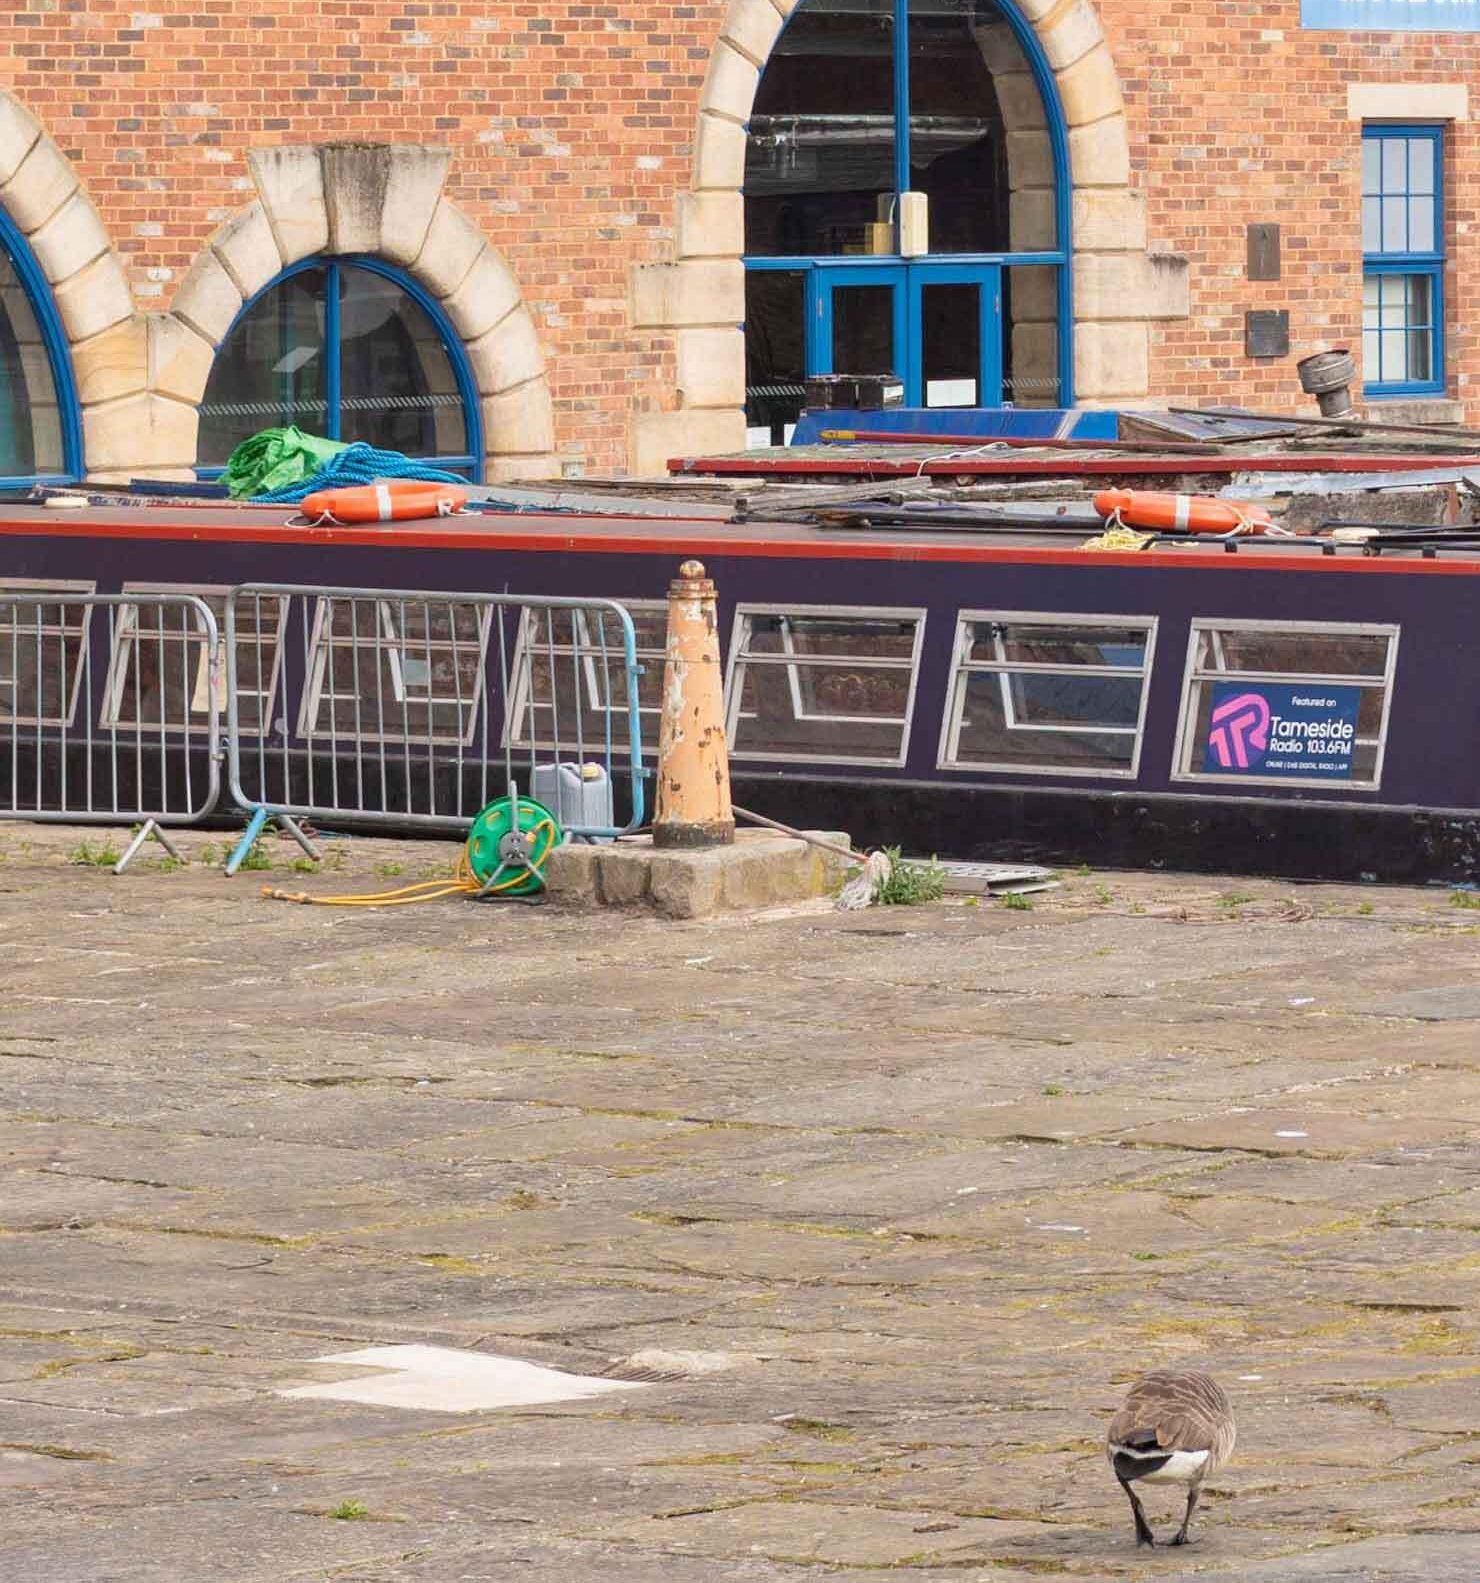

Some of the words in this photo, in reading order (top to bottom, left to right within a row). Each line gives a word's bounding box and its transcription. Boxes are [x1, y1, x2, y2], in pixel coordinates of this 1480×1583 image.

[1291, 696, 1325, 707] Featured
[1326, 699, 1337, 707] on
[1270, 716, 1354, 739] Tameside
[1269, 738, 1303, 753] Radio
[1307, 739, 1352, 755] 103.6FM
